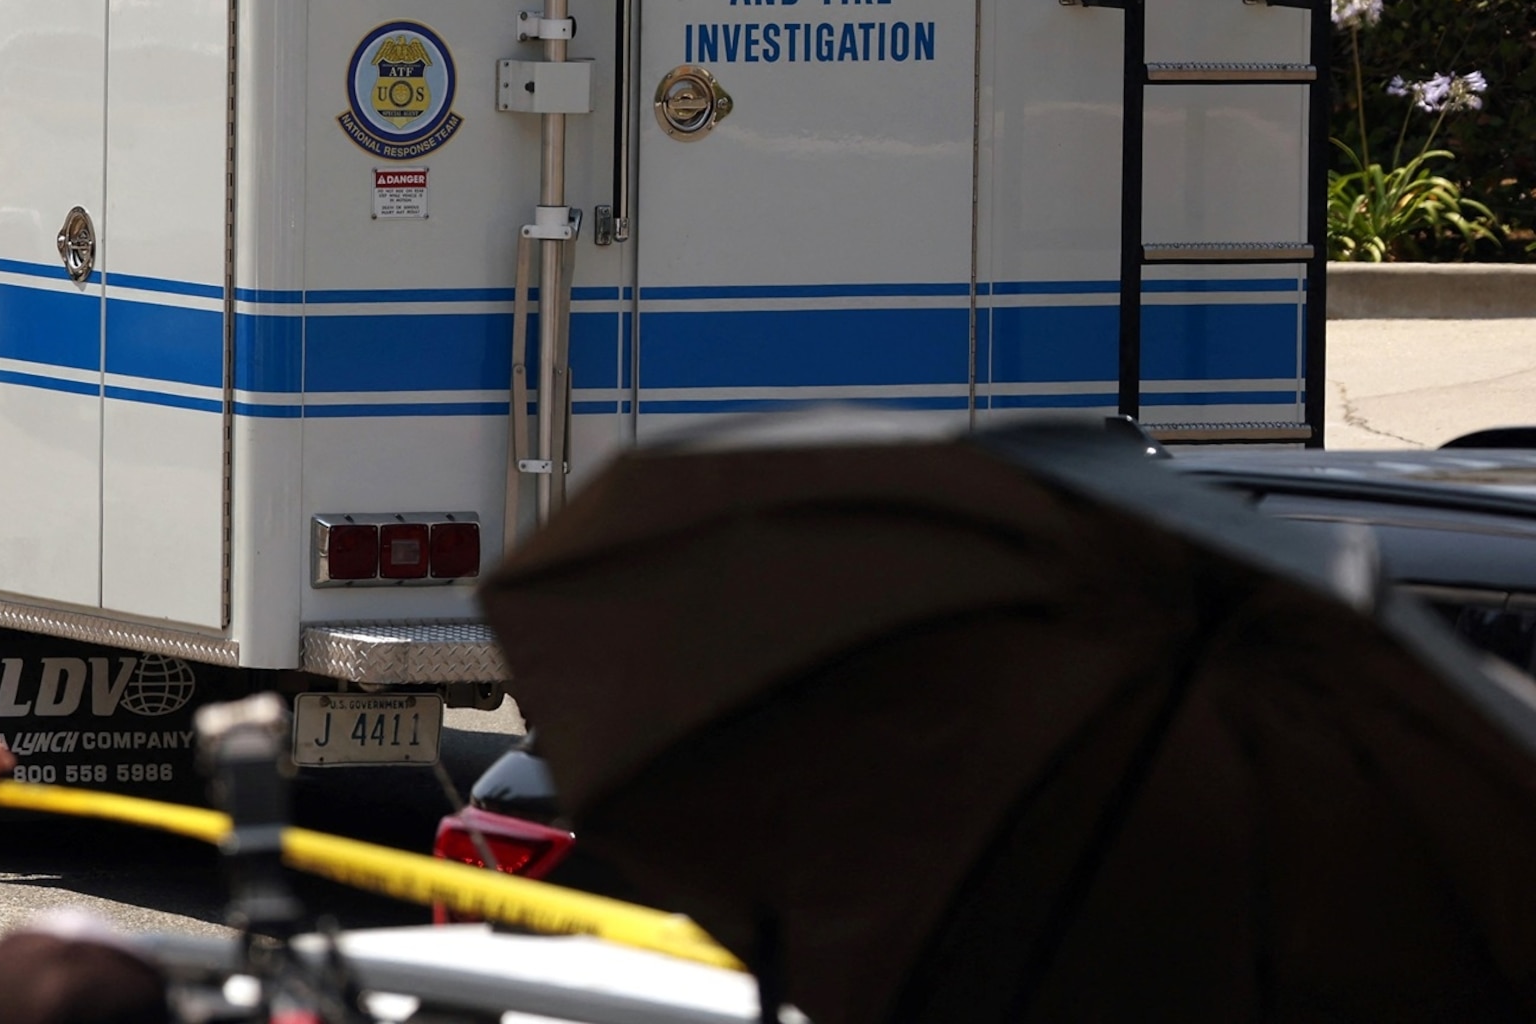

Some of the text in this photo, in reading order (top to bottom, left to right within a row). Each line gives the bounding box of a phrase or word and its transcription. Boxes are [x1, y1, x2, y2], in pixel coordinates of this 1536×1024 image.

[685, 22, 935, 63] INVESTIGATION
[389, 66, 414, 77] ATF
[377, 86, 425, 102] U S
[342, 114, 459, 157] NATIONAL RESPONSE TEAM
[386, 174, 425, 184] DANGER
[330, 699, 409, 710] U.S. GOVERNMENT
[314, 712, 420, 747] J 4411
[11, 731, 79, 756] LYNCH
[82, 731, 194, 750] COMPANY
[14, 763, 173, 783] 800 558 5986
